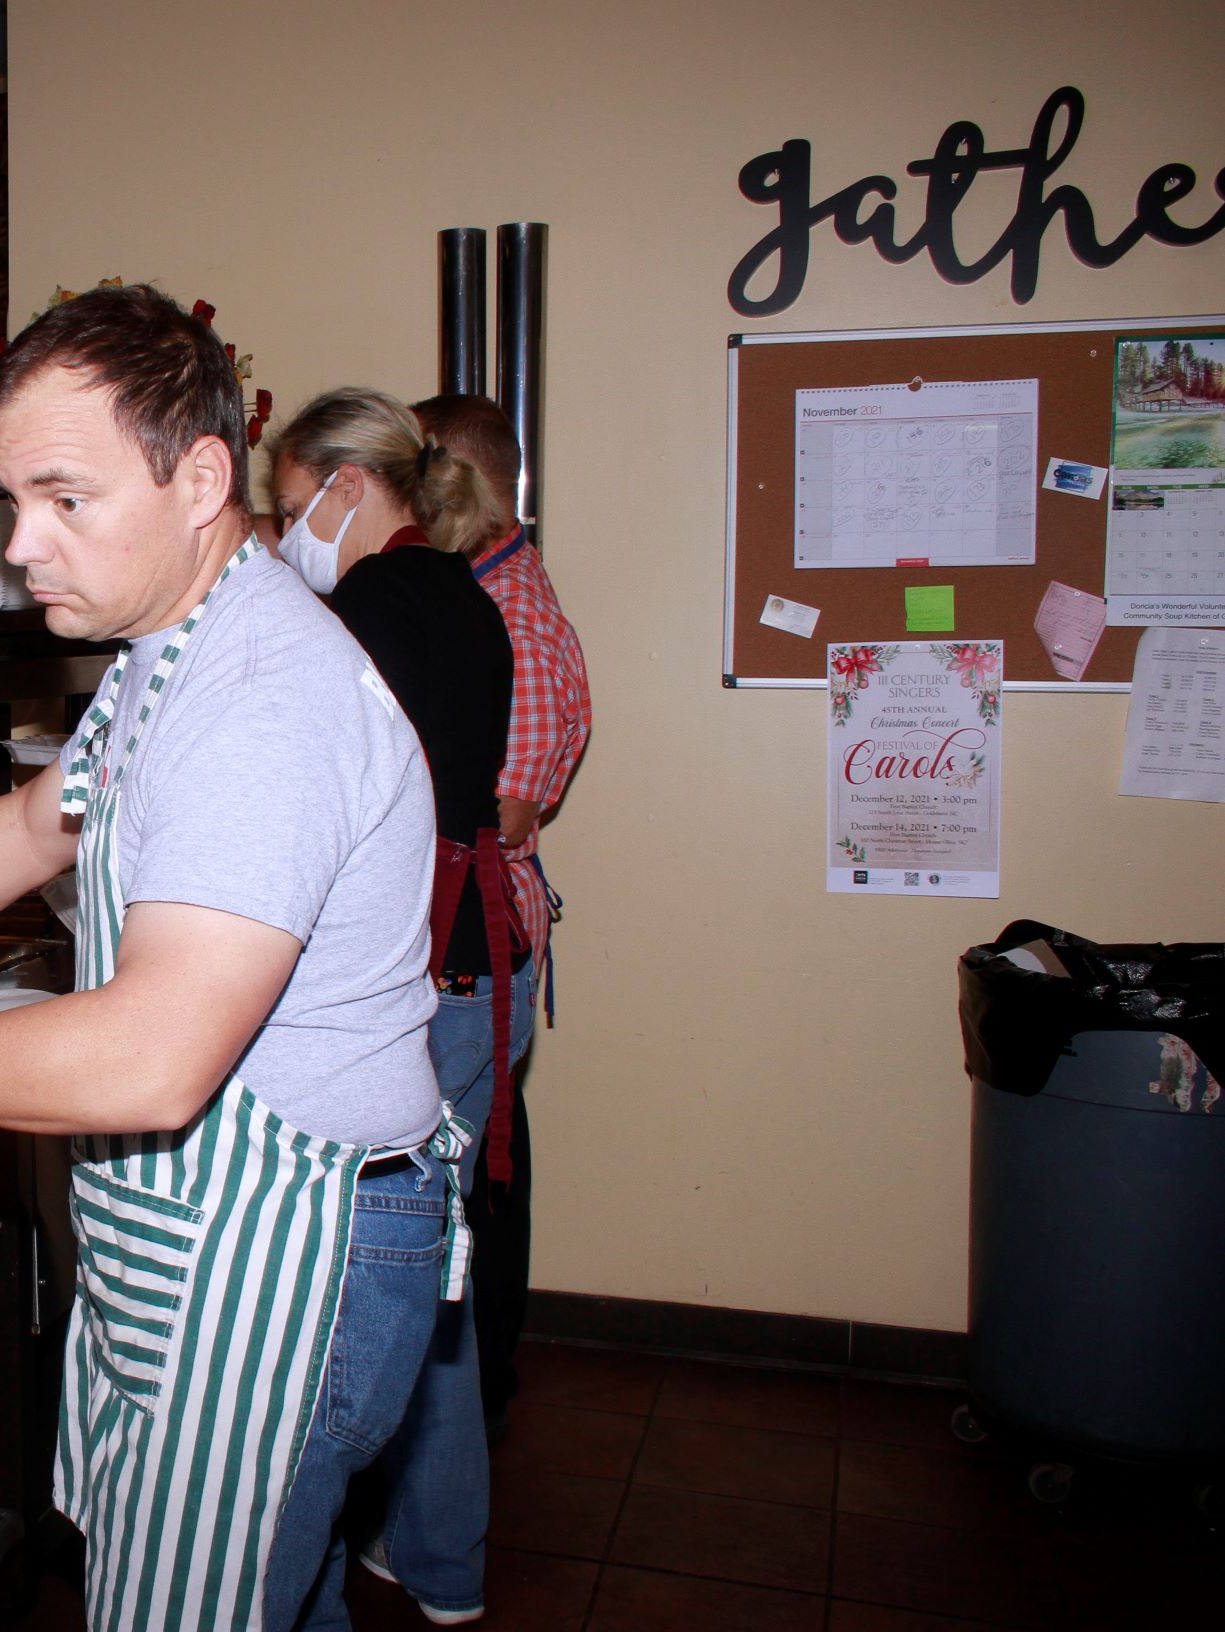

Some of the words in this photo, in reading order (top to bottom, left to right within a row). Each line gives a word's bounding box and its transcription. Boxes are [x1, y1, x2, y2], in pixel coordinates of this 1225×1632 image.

[727, 86, 1225, 318] gathe
[802, 407, 858, 418] November
[860, 405, 883, 416] 2021
[1123, 612, 1163, 620] Community
[1164, 612, 1183, 620] Soup
[877, 675, 888, 686] III
[890, 674, 951, 686] CENTURY
[888, 687, 941, 699] SINGERS
[881, 706, 905, 714] 45TH
[906, 706, 948, 714] ANNUAL
[870, 716, 917, 729] Christmas
[922, 716, 960, 729] Concert
[876, 741, 923, 751] FESTIVAL
[923, 740, 938, 751] OF
[843, 728, 985, 785] Carols
[850, 794, 893, 803] December
[896, 794, 908, 804] 12,
[910, 794, 930, 803] 2021
[941, 795, 961, 804] 3:00
[850, 822, 893, 831] December
[895, 823, 908, 832] 14,
[909, 823, 930, 832] 2021
[941, 824, 961, 833] 7:00
[962, 826, 977, 834] pm
